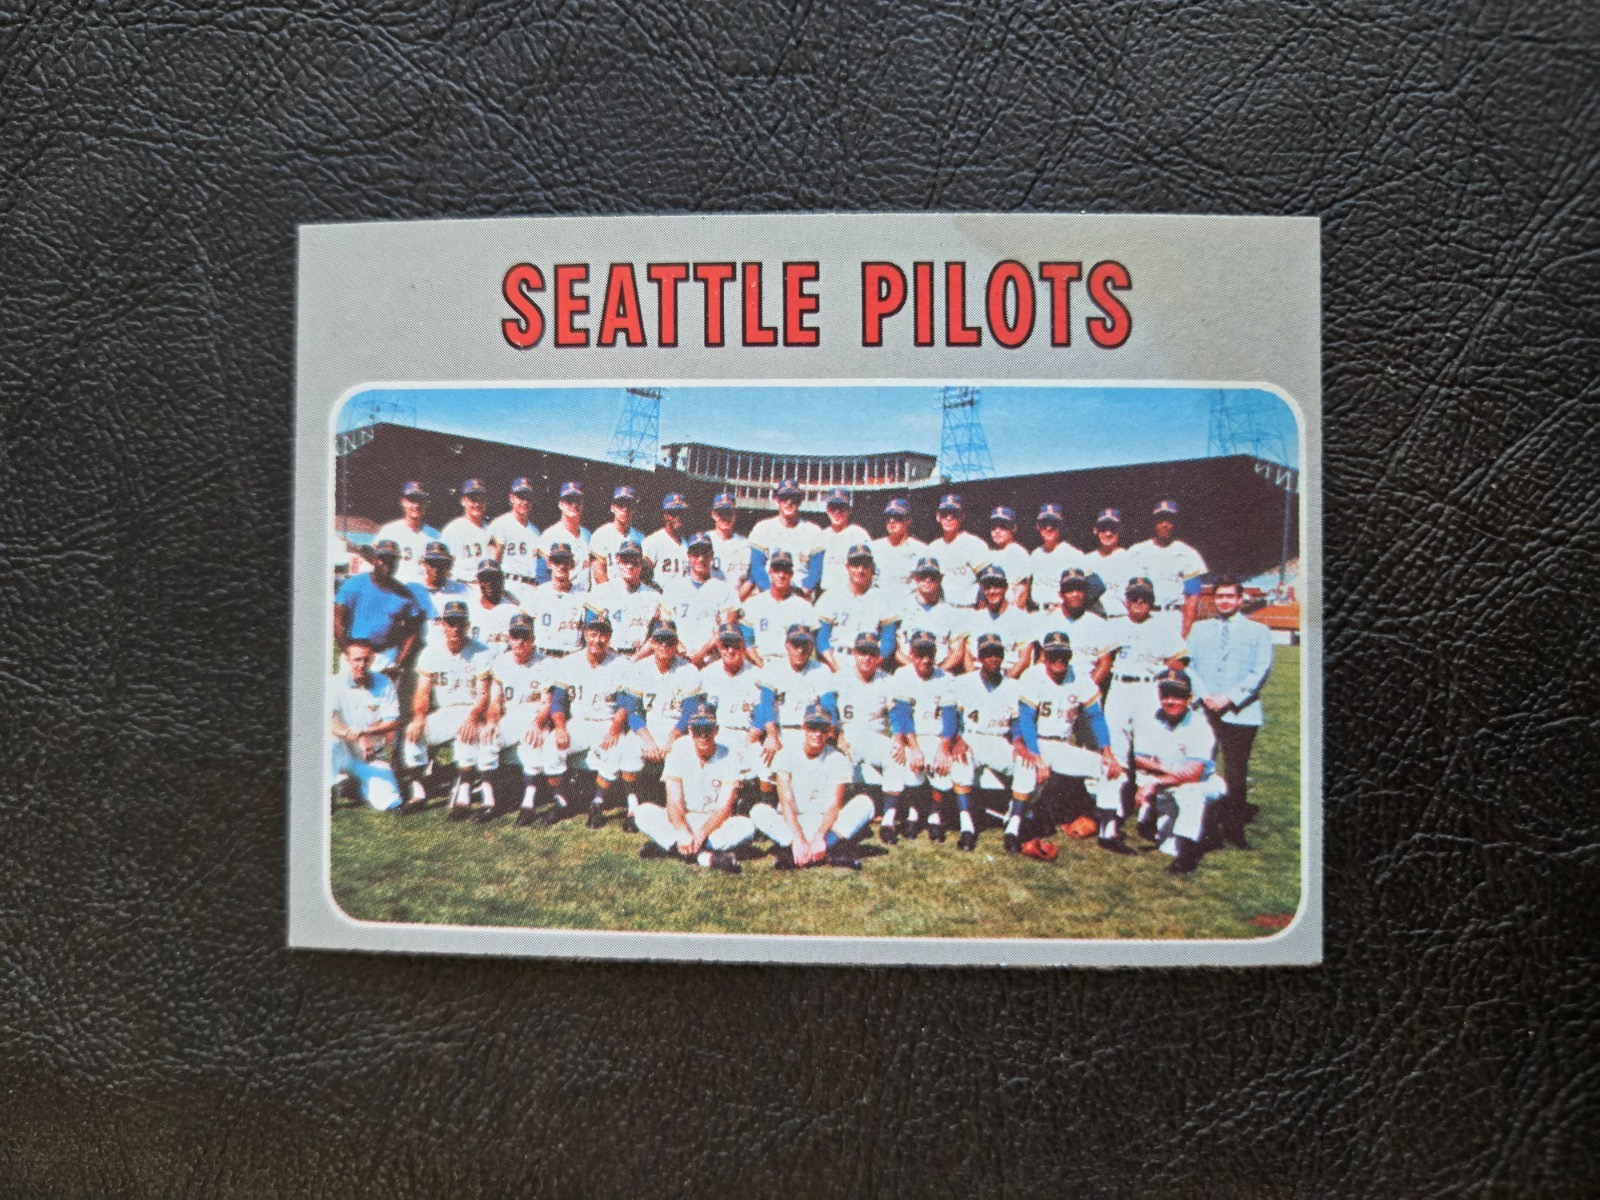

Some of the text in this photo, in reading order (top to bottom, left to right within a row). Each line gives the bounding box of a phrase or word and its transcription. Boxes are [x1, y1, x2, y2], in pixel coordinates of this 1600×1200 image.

[501, 259, 1133, 350] SEATTLE PILOTS
[506, 541, 528, 557] 26
